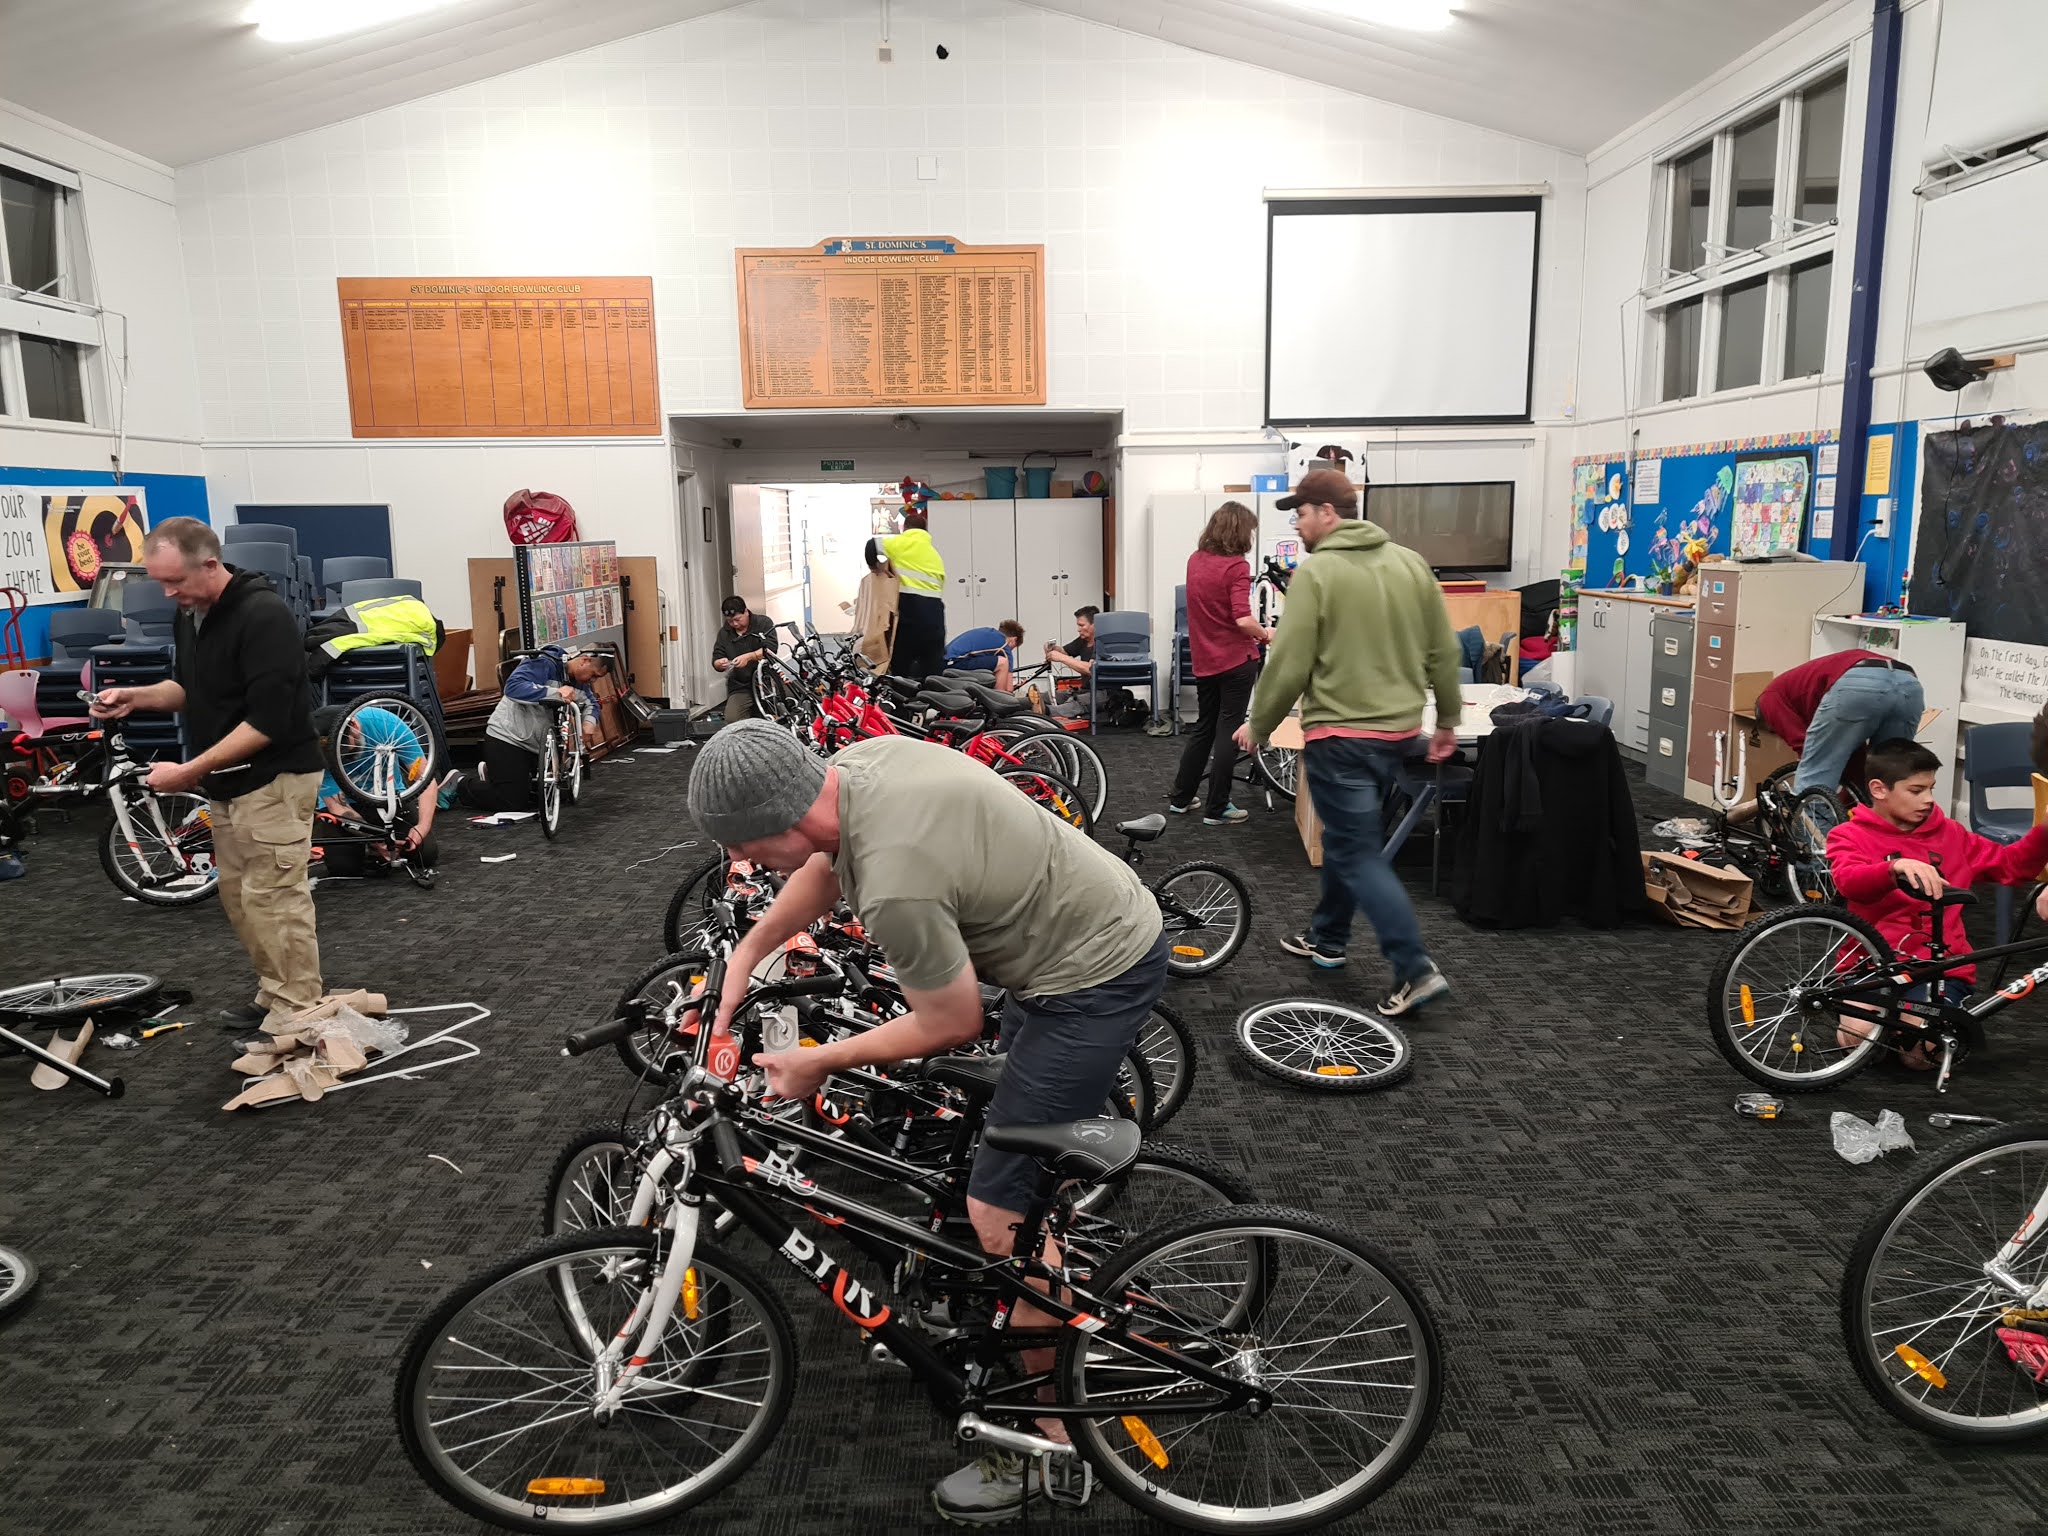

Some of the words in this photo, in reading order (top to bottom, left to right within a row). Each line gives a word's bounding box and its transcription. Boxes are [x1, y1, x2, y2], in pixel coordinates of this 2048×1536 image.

[864, 241, 876, 249] ST.
[878, 240, 927, 249] DOMINIC'S
[844, 255, 875, 264] INDOOR
[878, 255, 916, 264] BOWLING
[919, 255, 939, 263] CLUB
[410, 285, 423, 294] ST
[424, 285, 472, 294] DOMINIC'S
[475, 285, 510, 294] INDOOR
[512, 284, 554, 294] BOWLING
[557, 284, 581, 293] CLUB
[1, 495, 27, 519] OUR
[3, 530, 35, 557] 2019
[76, 542, 86, 551] be
[5, 569, 44, 595] THEME
[1980, 647, 1990, 659] On
[2005, 669, 2026, 682] called
